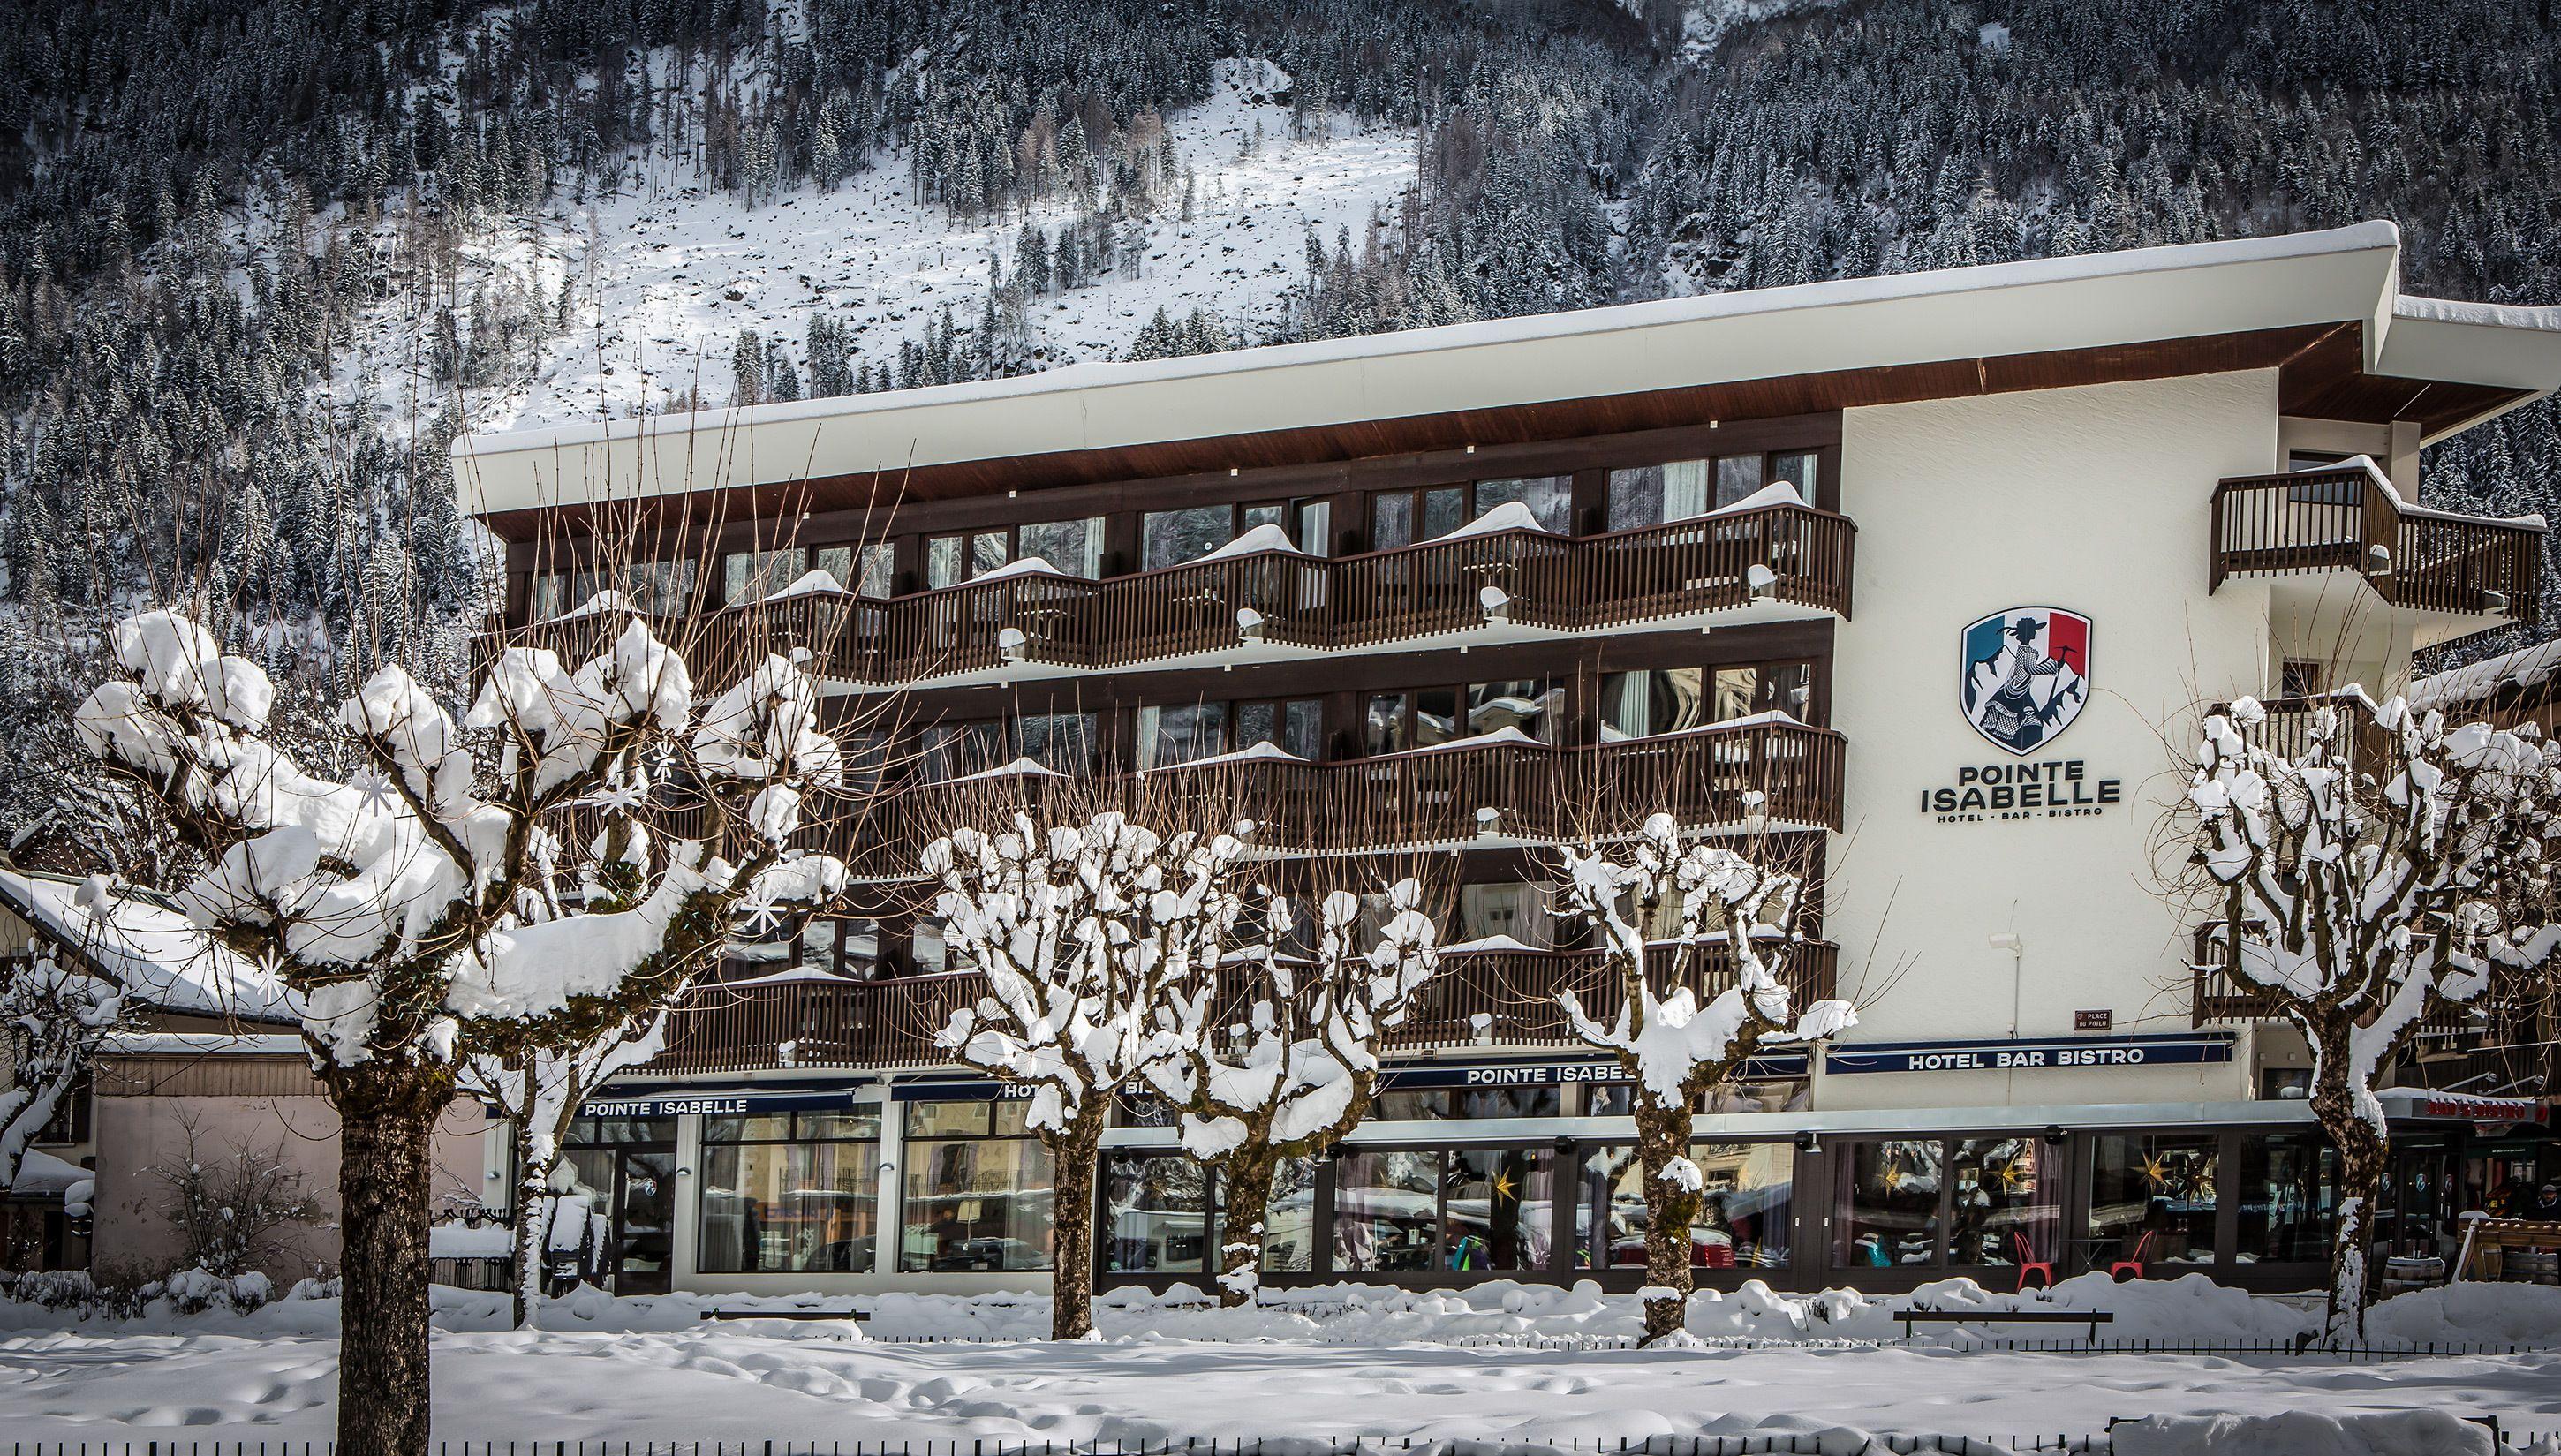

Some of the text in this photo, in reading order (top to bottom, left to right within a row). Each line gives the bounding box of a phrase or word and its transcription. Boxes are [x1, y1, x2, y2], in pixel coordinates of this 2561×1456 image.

[1959, 760, 2084, 787] POINTE
[1921, 780, 2120, 813] ISABELLE
[1938, 814, 1983, 823] HOTEL
[2049, 807, 2103, 818] BISTRO
[1908, 1048, 2144, 1070] HOTEL BAR BISTRO
[1467, 1068, 1546, 1084] POINTE
[585, 1100, 748, 1116] POINTE ISABELLE
